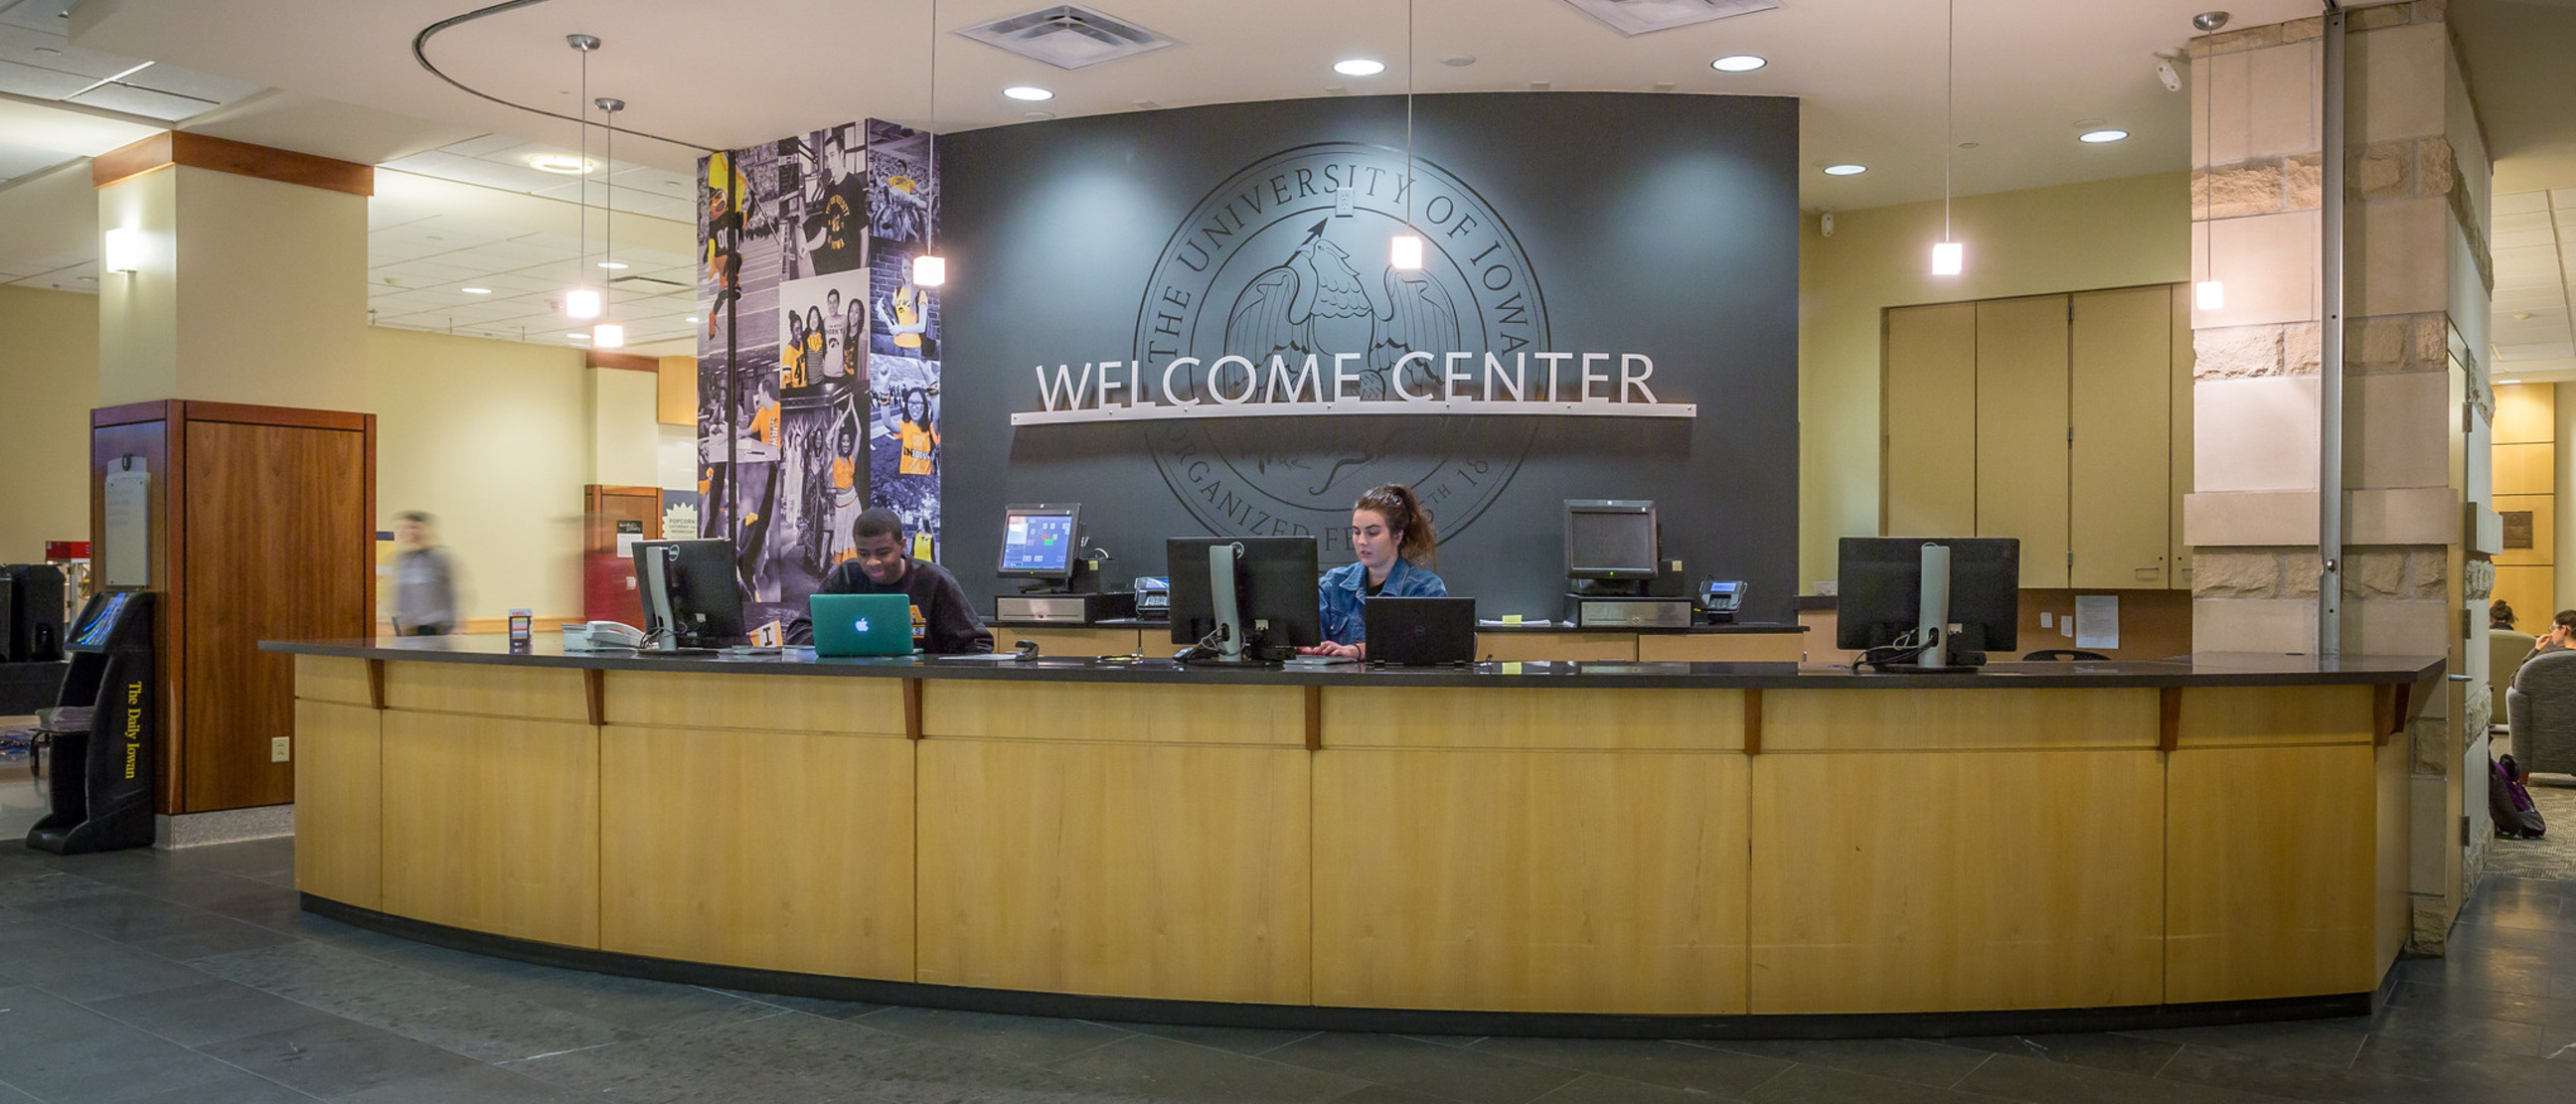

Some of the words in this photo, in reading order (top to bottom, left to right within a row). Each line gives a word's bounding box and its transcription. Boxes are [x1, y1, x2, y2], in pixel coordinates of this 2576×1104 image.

[1148, 285, 1192, 365] THE
[1176, 163, 1417, 272] UNIVERSITY
[1425, 195, 1478, 238] OF
[1469, 239, 1530, 358] IOWA
[1036, 352, 1362, 411] WELCOME
[1391, 351, 1659, 404] CENTER
[128, 681, 142, 705] The
[124, 708, 142, 739] Daily
[125, 743, 140, 779] Iowan
